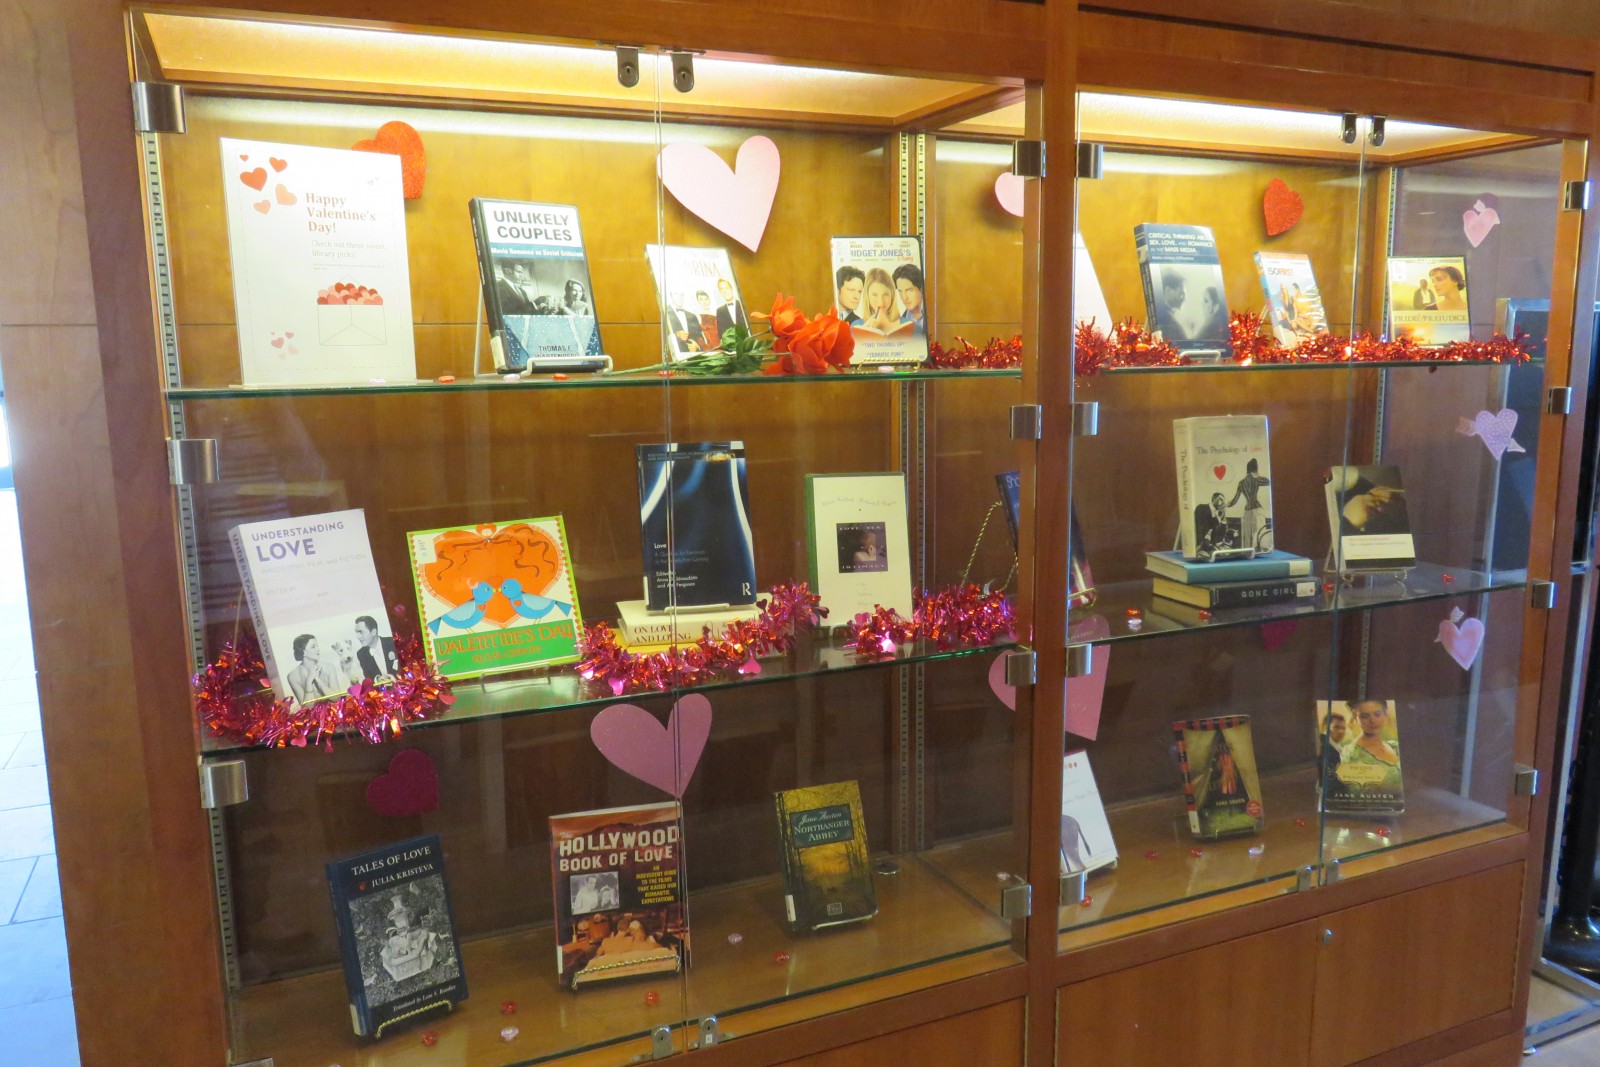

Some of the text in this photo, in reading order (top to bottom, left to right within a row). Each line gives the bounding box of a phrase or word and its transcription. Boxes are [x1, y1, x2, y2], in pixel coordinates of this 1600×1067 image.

[306, 193, 346, 208] Happy
[306, 206, 376, 221] Valentine's
[493, 210, 569, 226] UNLIKELY
[308, 220, 336, 235] Day!
[497, 226, 573, 241] COUPLES
[312, 240, 332, 248] Check
[312, 250, 336, 259] library
[878, 249, 911, 257] JONES'S
[252, 522, 344, 541] UNDERSTANDING
[256, 538, 316, 562] LOVE
[742, 582, 752, 596] R
[1241, 587, 1295, 598] GONE GIRL
[232, 534, 271, 662] UNDERSTANDING LOVE
[634, 624, 675, 635] ON LOVE
[437, 621, 575, 656] VALENTINE'S DAY
[635, 633, 691, 644] AND LOVING
[560, 831, 575, 839] The
[794, 820, 850, 836] NORTHANGER
[559, 826, 680, 857] HOLLYWOOD
[808, 830, 838, 842] ABBEY
[351, 845, 431, 877] TALES OF LOVE
[560, 845, 673, 872] BOOK OF LOVE
[371, 863, 435, 888] JULIA KRISTEVA
[641, 895, 675, 905] EXPECTATIONS
[645, 889, 670, 897] ROMANTIC
